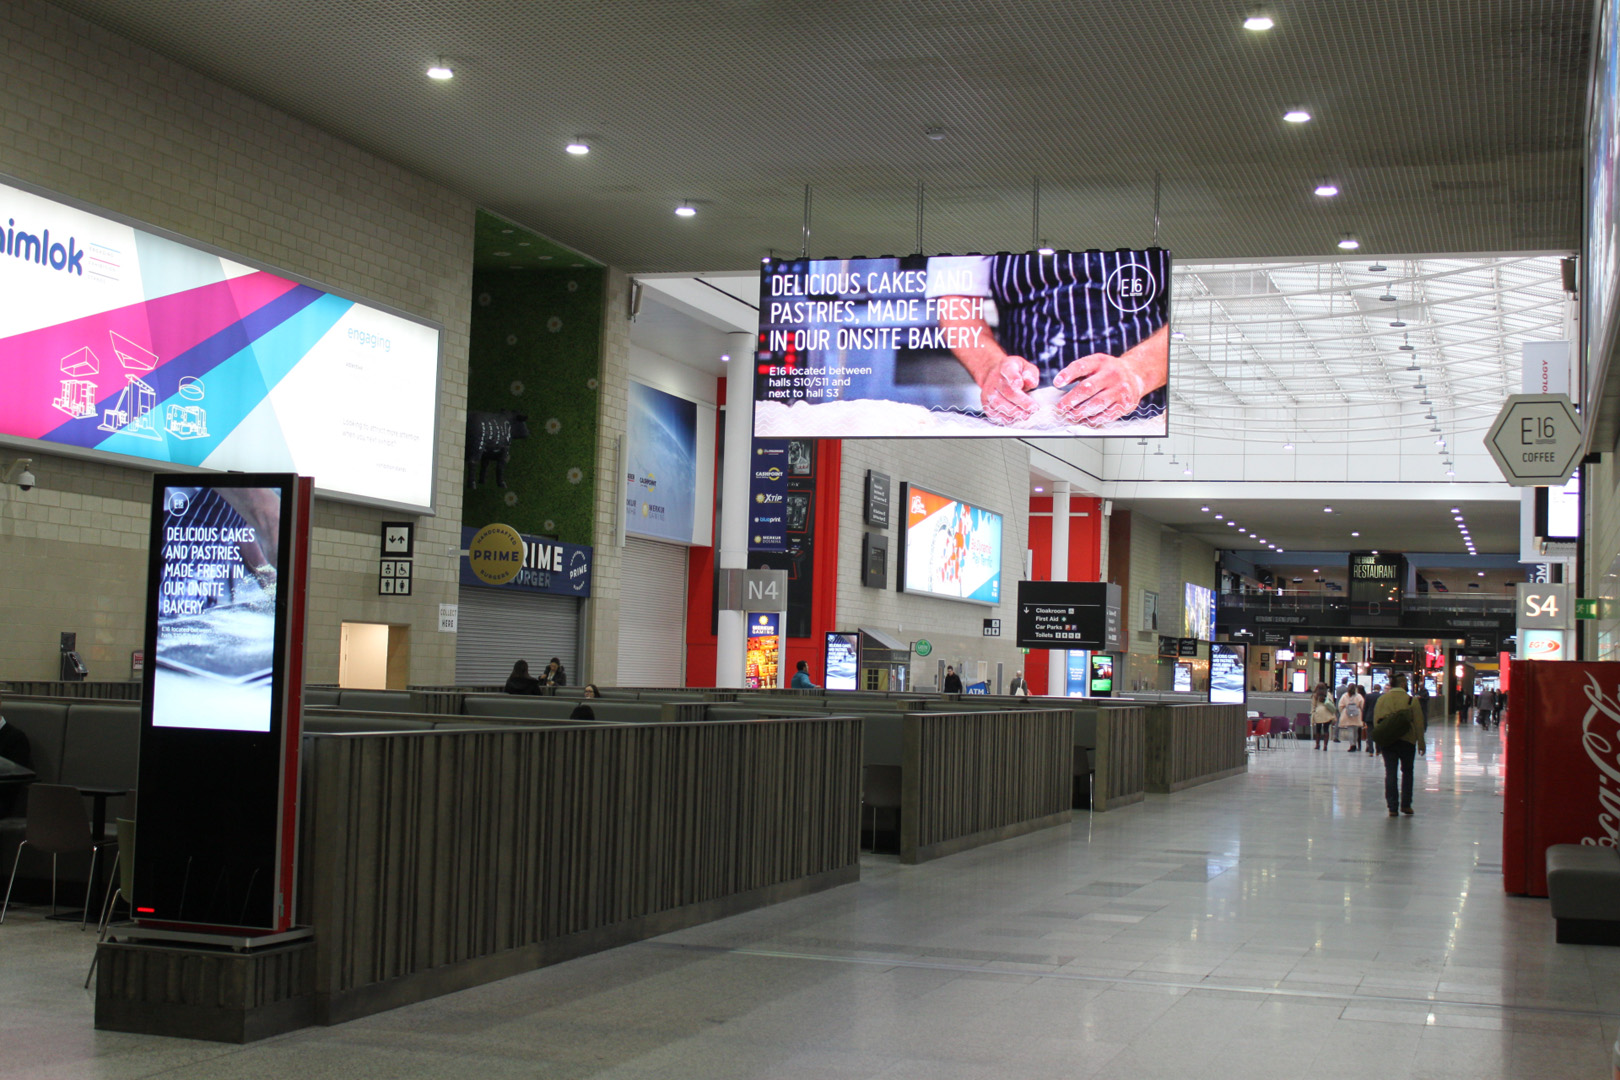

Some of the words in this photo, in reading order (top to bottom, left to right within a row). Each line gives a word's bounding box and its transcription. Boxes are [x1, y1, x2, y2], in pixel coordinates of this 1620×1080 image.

[771, 272, 861, 296] DELICIOUS
[866, 270, 927, 294] CAKES
[932, 270, 973, 293] AND
[1121, 278, 1142, 297] E16
[770, 301, 860, 324] PASTRIES,
[867, 299, 919, 322] MADE
[925, 298, 984, 321] FRESH
[769, 329, 787, 352] IN
[794, 329, 830, 351] OUR
[836, 327, 901, 350] ONSITE
[908, 326, 985, 349] BAKERY.
[769, 366, 787, 376] E16
[789, 365, 826, 376] located
[829, 366, 872, 375] between
[1541, 360, 1549, 394] OLOGY
[769, 378, 791, 387] halls
[793, 377, 829, 387] S10/S11
[831, 377, 851, 386] and
[769, 389, 790, 398] next
[793, 389, 803, 398] to
[806, 388, 823, 397] hall
[826, 389, 839, 397] S3
[1521, 416, 1555, 445] E16
[1522, 452, 1555, 462] COFFEE
[167, 527, 219, 542] DELICIOUS
[220, 528, 256, 543] CAKES
[477, 528, 517, 546] HANDCRAFTED
[165, 545, 188, 560] AND
[190, 545, 243, 562] PASTRIES,
[473, 550, 520, 562] PRIME
[521, 541, 564, 572] RIME
[164, 563, 194, 578] MADE
[197, 563, 230, 579] FRESH
[232, 564, 245, 579] IN
[508, 570, 551, 587] URGER
[569, 563, 588, 579] PRIME
[1353, 564, 1397, 578] RESTAURANT
[1535, 563, 1547, 584] OM
[164, 581, 185, 596] OUR
[187, 581, 225, 597] ONSITE
[748, 580, 779, 600] N4
[162, 599, 206, 615] BAKERY.
[440, 608, 457, 617] COLLECT
[1525, 594, 1560, 617] S4
[441, 619, 454, 628] HERE
[1528, 641, 1545, 649] EGT
